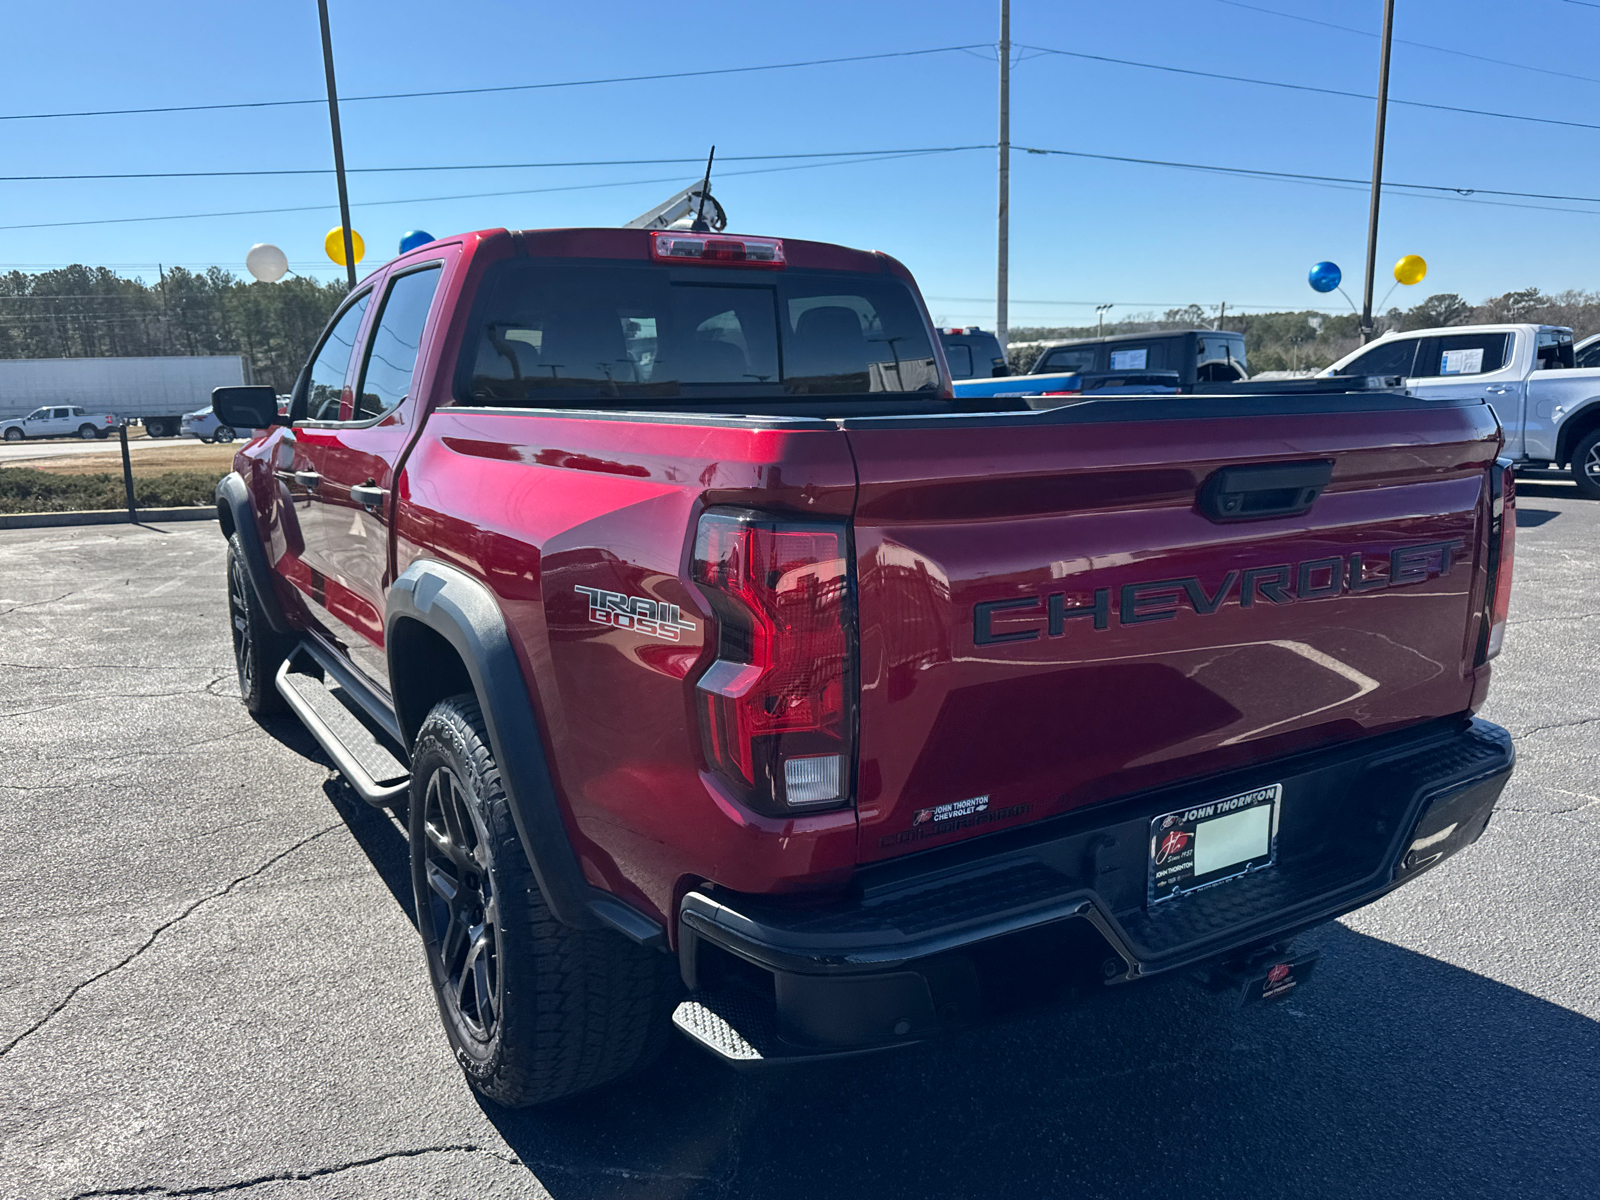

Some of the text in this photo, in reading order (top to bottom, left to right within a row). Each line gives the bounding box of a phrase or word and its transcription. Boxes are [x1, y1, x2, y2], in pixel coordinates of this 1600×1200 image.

[574, 584, 696, 631] TRAIL
[972, 538, 1465, 647] CHEVROLET
[589, 607, 680, 642] BOSS
[933, 795, 989, 815] JOHN THORNTON
[933, 806, 975, 822] CHEVROLET
[1182, 788, 1276, 822] JOHN THORNTON
[1156, 861, 1194, 878] JOHN THORNTON
